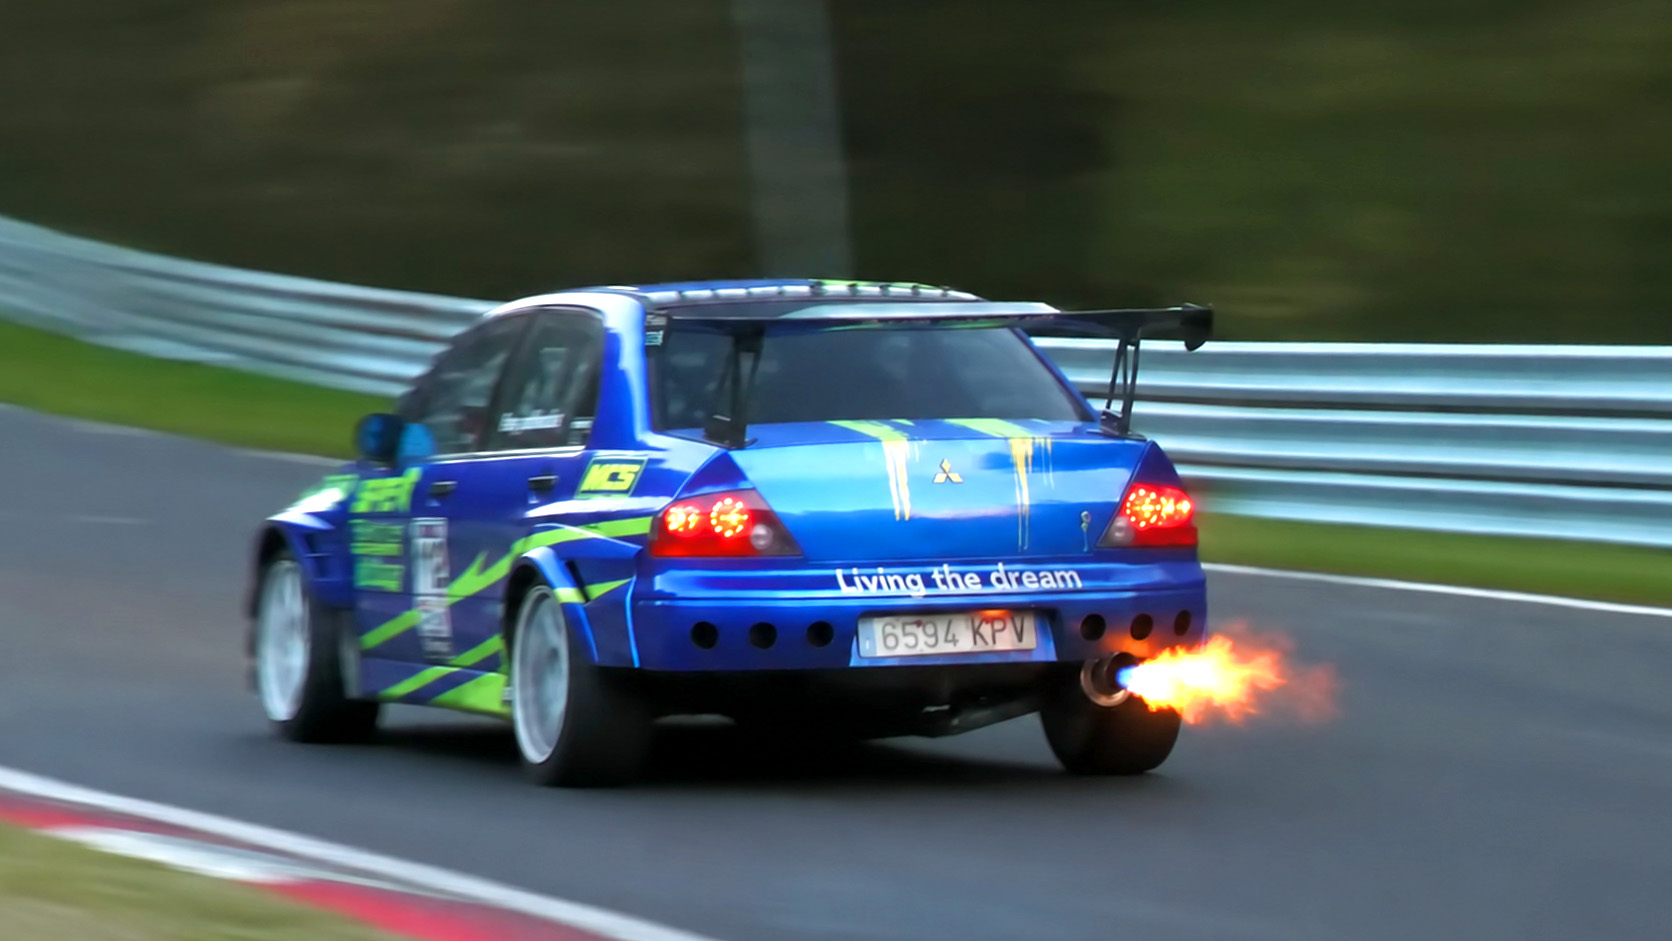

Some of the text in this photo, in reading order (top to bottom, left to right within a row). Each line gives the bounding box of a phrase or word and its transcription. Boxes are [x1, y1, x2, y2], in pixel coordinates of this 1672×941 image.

[580, 464, 641, 491] MCS
[835, 562, 1083, 598] Living the dream
[881, 616, 1025, 651] 6594 KPV
